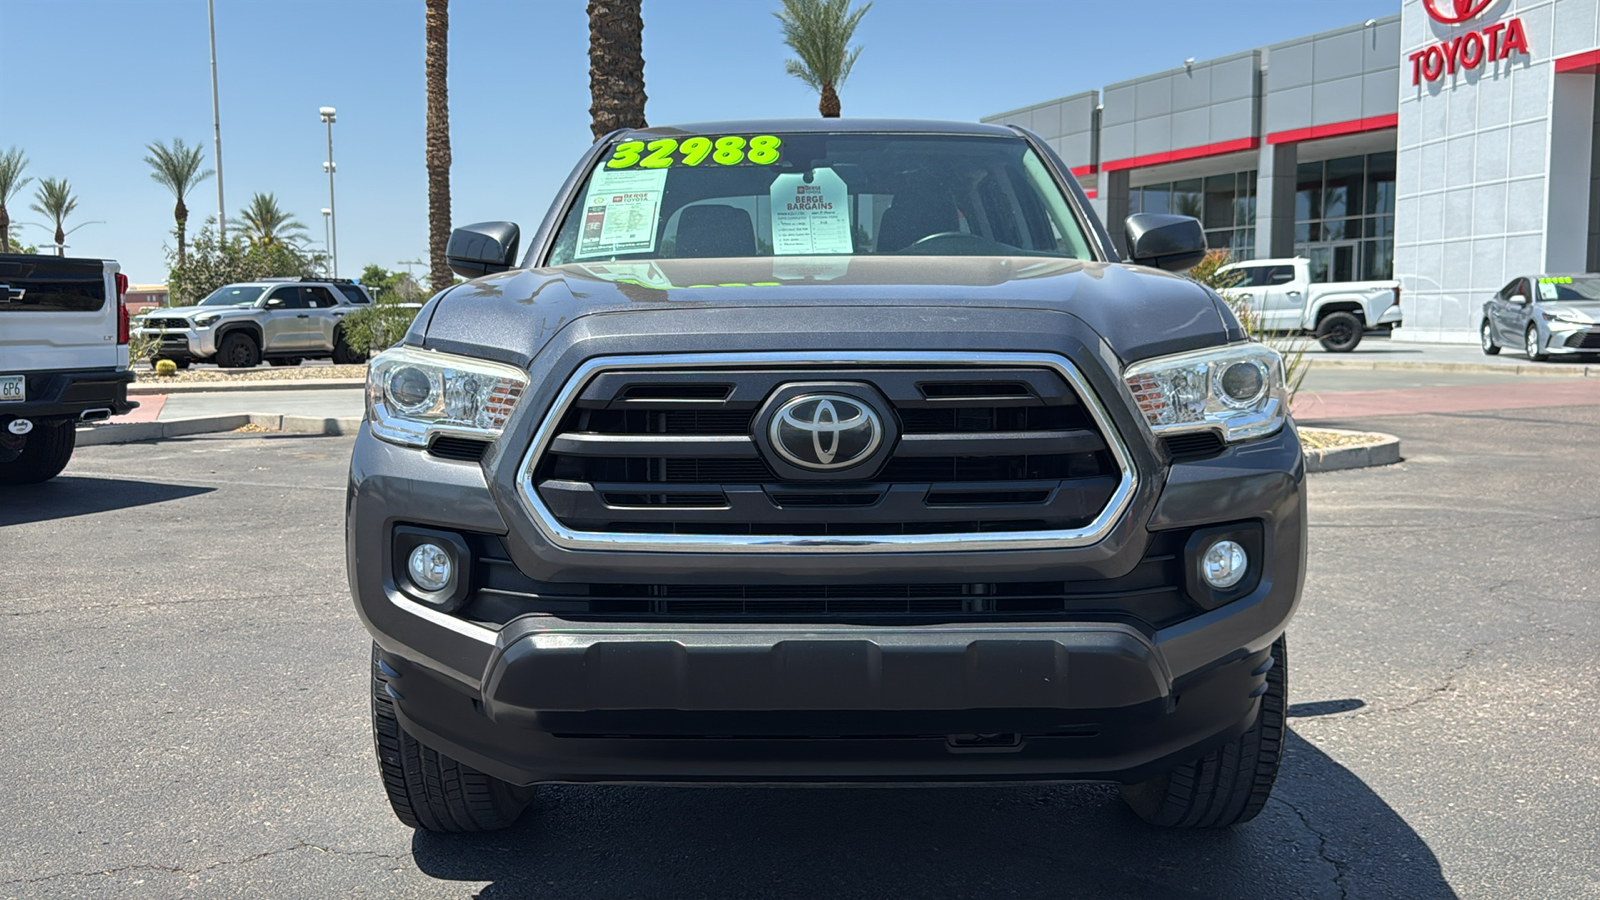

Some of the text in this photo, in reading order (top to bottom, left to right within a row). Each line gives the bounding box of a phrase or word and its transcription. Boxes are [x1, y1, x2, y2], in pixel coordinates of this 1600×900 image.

[1409, 18, 1528, 86] TOYOTA
[606, 135, 782, 169] 32988
[3, 382, 20, 396] 6P6
